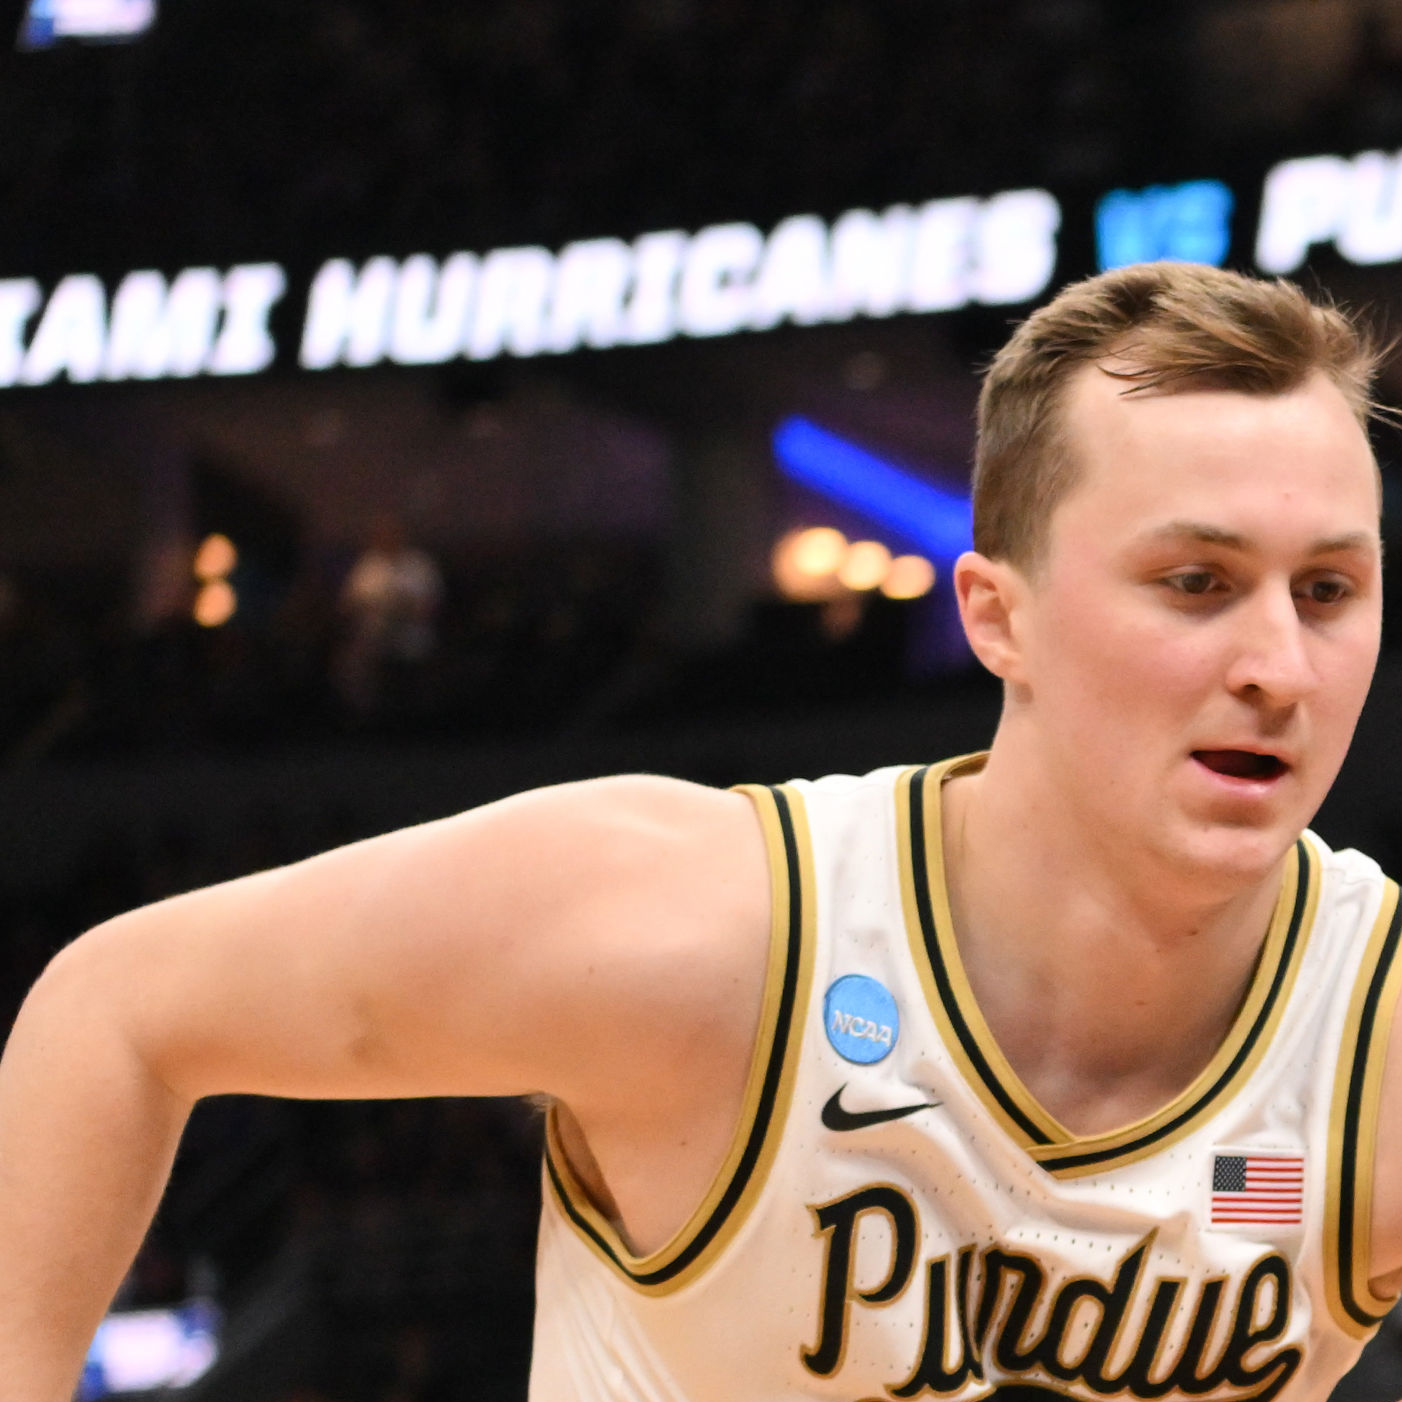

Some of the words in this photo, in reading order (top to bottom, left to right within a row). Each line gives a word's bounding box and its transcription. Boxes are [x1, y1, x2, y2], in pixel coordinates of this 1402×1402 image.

[297, 186, 1061, 371] HURRICANES
[831, 1009, 893, 1049] NCAA
[800, 1181, 1294, 1402] Purdue
